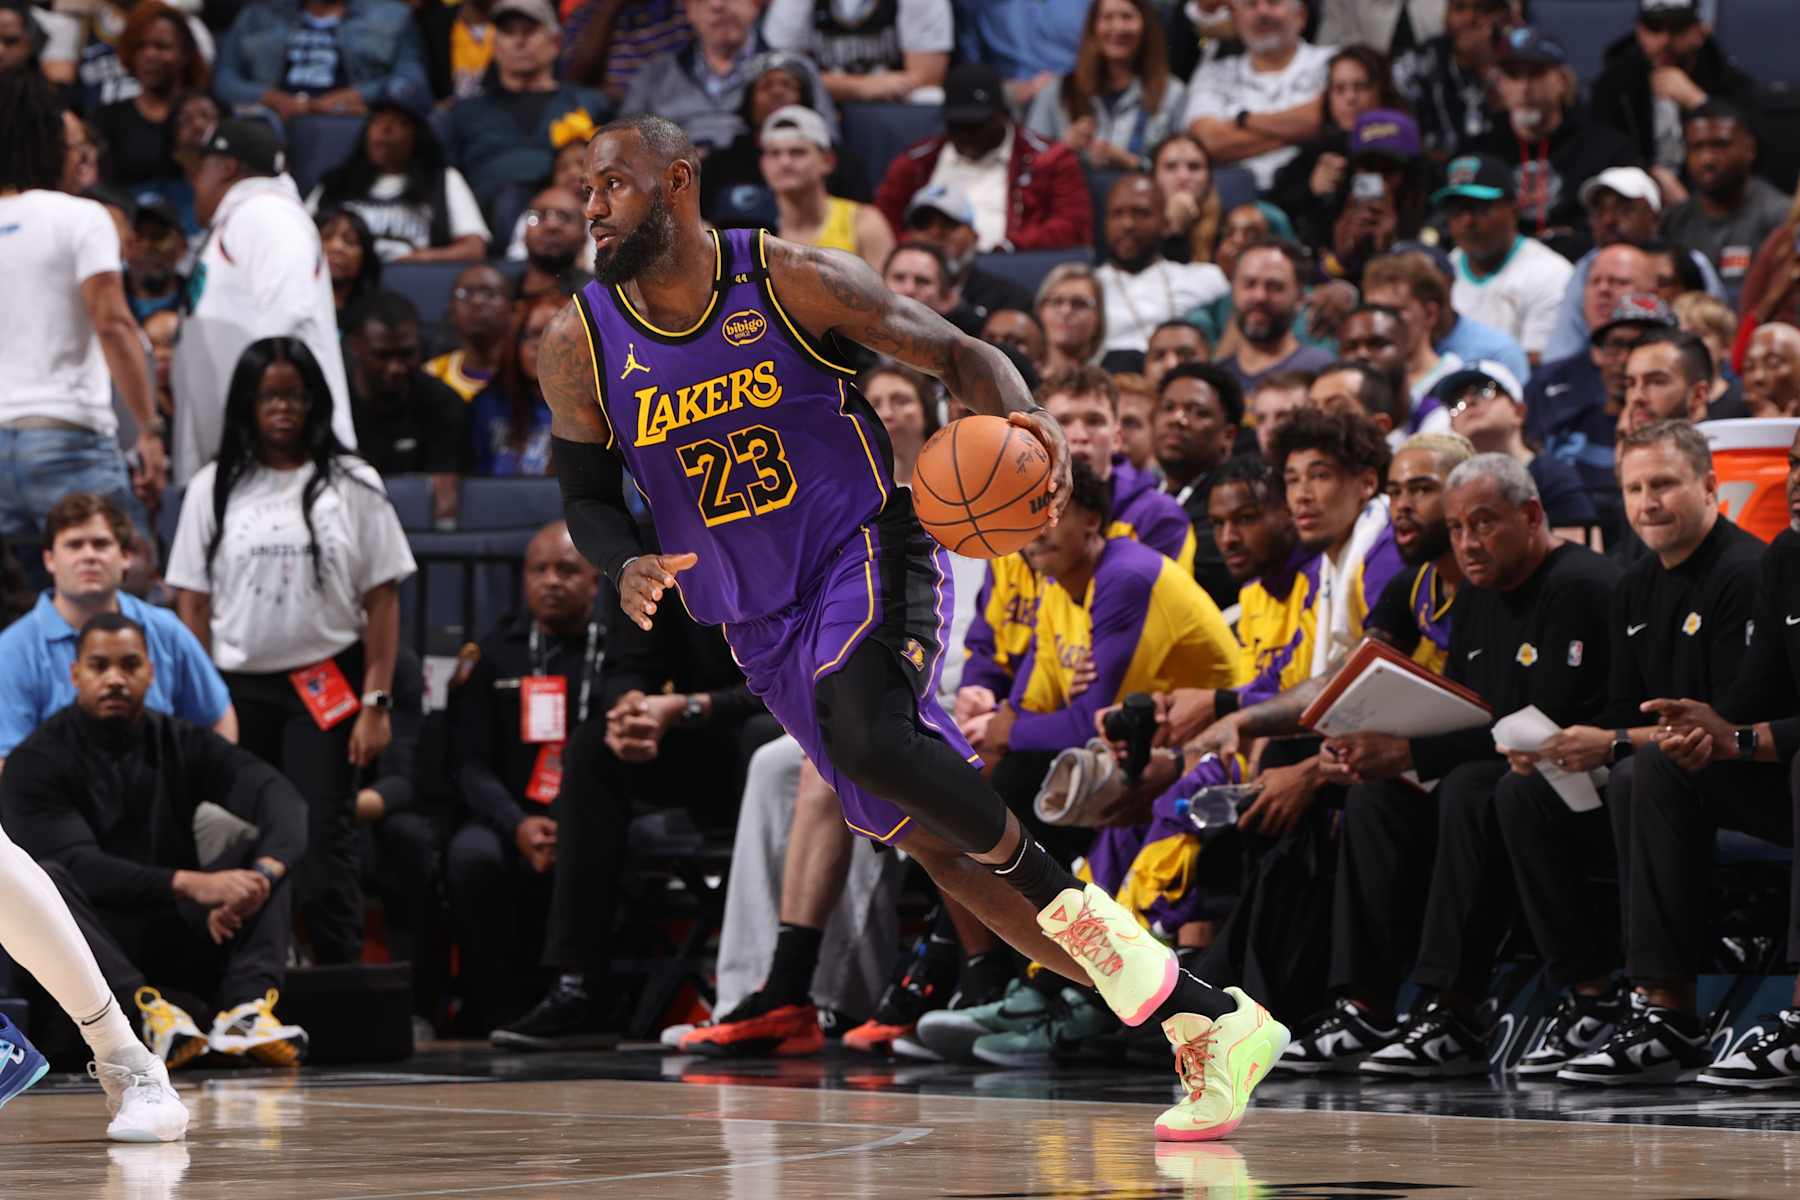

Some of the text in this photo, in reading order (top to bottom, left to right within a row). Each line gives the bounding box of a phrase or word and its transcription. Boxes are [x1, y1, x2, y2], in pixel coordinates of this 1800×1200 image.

[735, 273, 748, 284] 44
[725, 318, 764, 337] bibigo
[633, 360, 783, 448] LAKERS
[675, 423, 799, 528] 23
